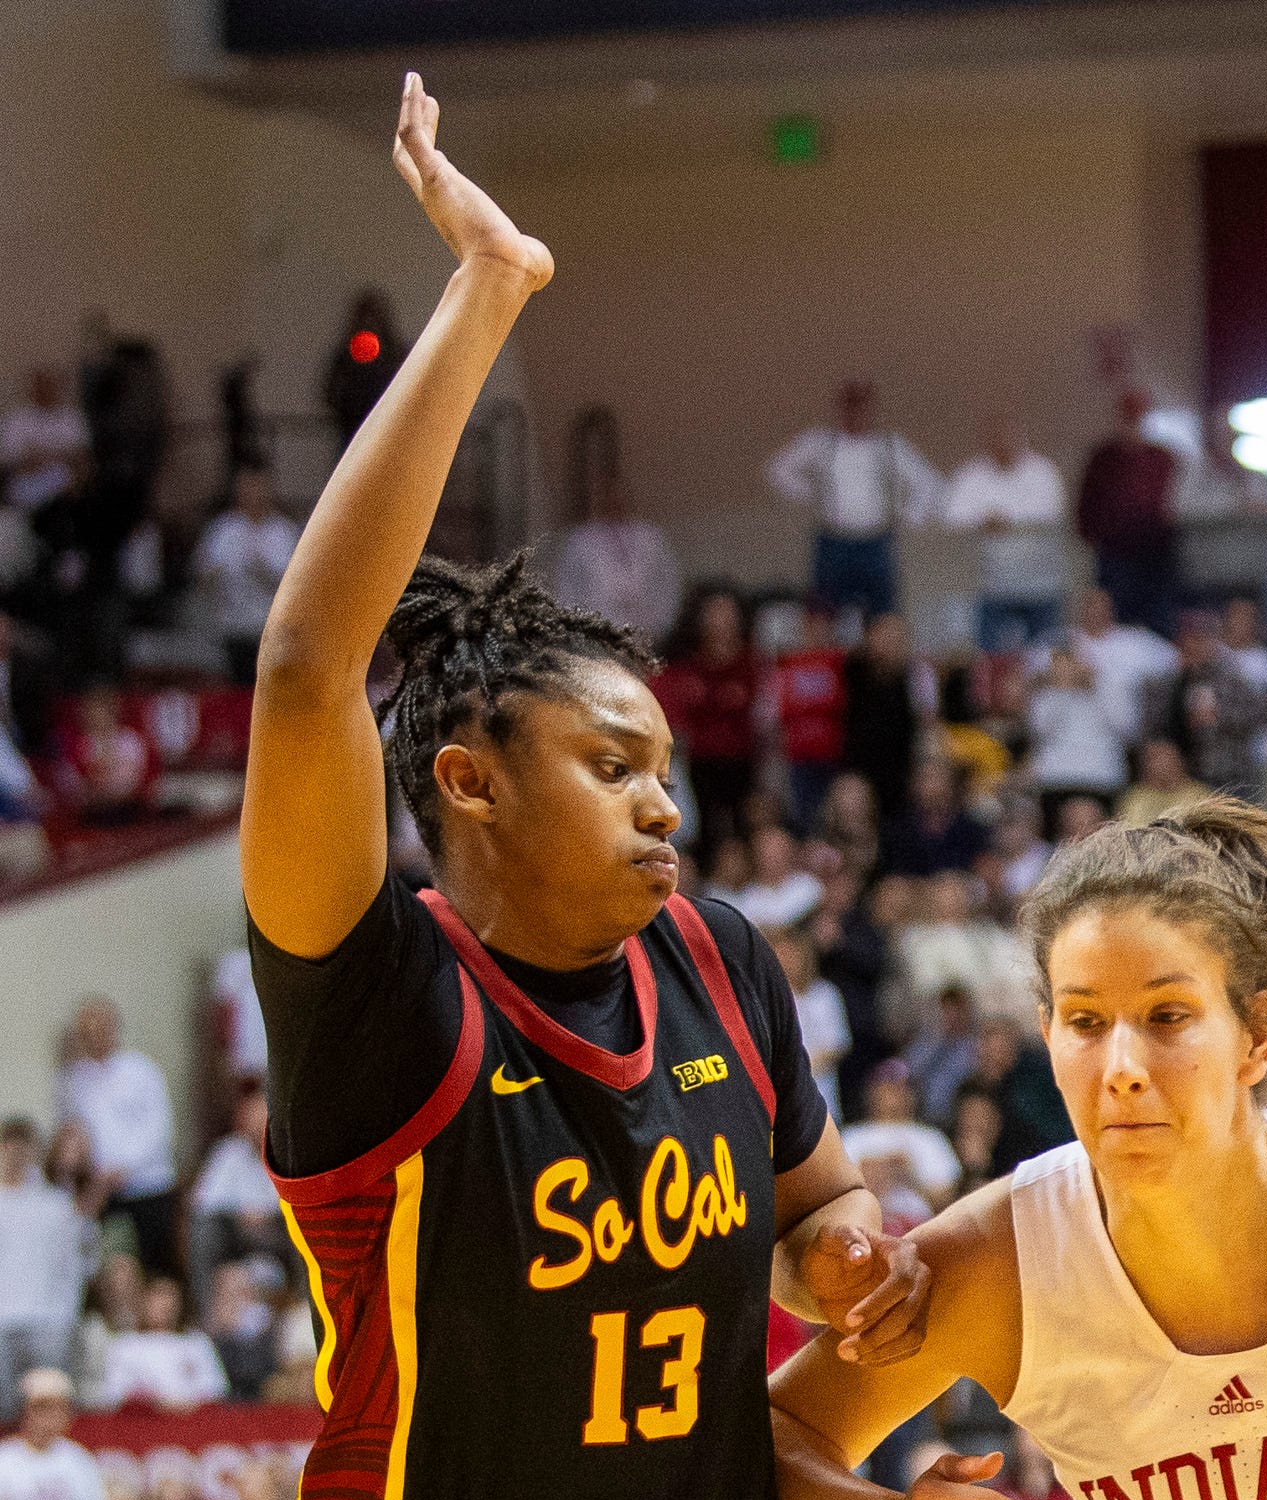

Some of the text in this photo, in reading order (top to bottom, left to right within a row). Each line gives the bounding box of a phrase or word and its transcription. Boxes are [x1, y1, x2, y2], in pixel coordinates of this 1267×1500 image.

[528, 1134, 747, 1291] So Cal
[582, 1304, 706, 1445] 13
[1208, 1398, 1265, 1417] adidas
